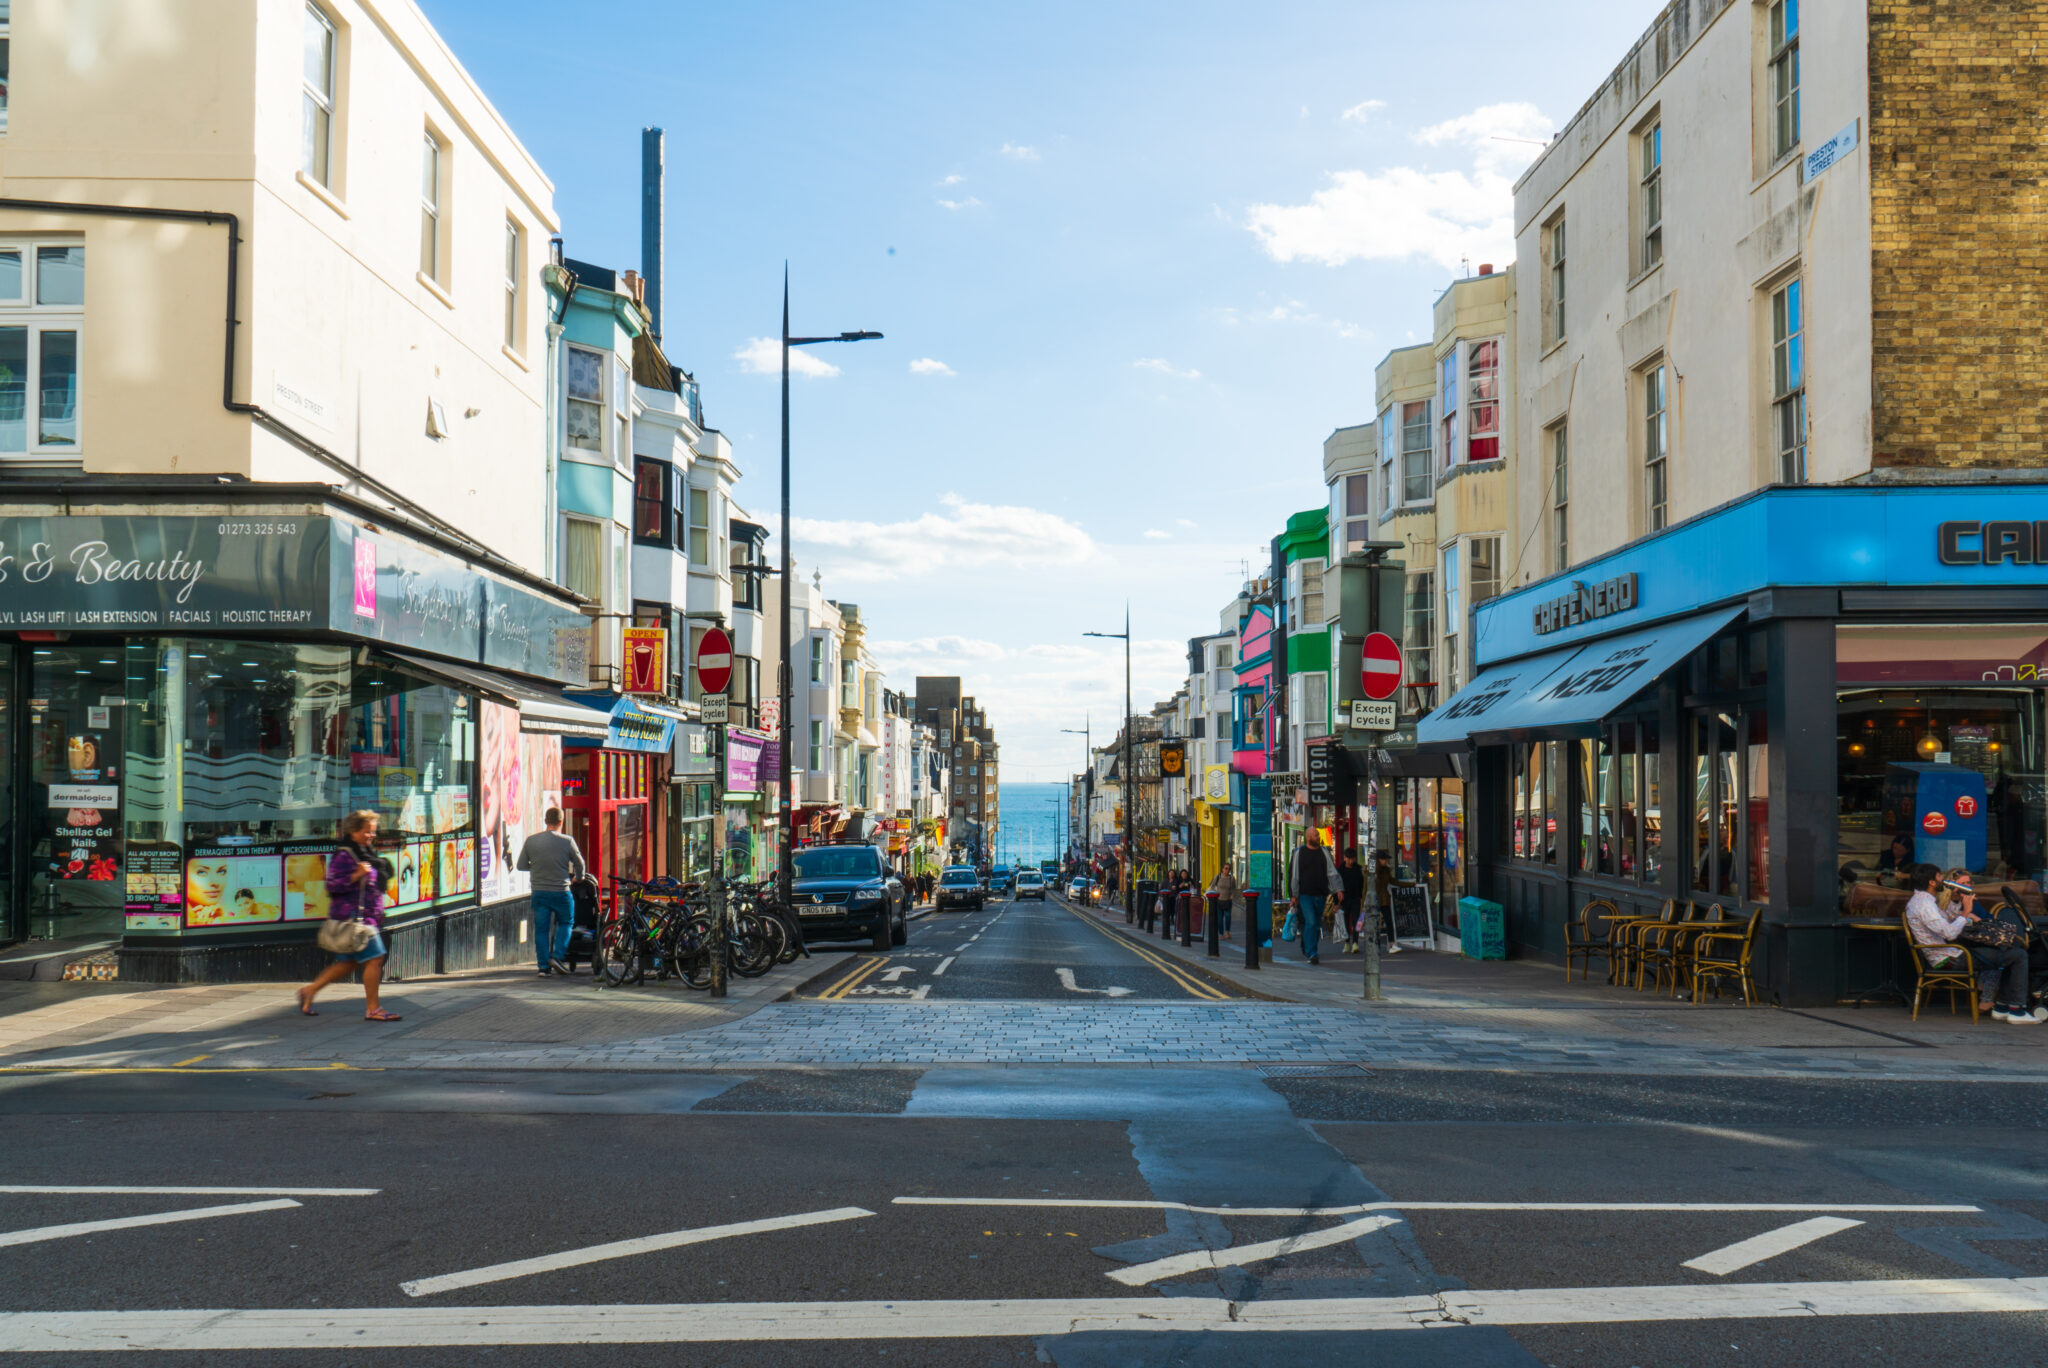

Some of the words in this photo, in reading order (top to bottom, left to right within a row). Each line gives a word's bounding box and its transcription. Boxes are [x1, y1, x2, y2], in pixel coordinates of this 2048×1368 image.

[1808, 136, 1838, 166] PRESTON
[1810, 152, 1834, 176] STREET
[218, 523, 252, 535] 01273
[254, 523, 274, 535] 325
[276, 523, 296, 535] 543
[70, 541, 206, 604] Beauty
[1582, 572, 1638, 621] NERO
[20, 611, 46, 624] LASH
[48, 611, 65, 624] LIFT
[76, 610, 100, 624] LASH
[102, 610, 158, 623] EXTENSION
[170, 610, 211, 623] FACIALS
[222, 610, 266, 623] HOLISTIC
[269, 610, 312, 622] THERAPY
[624, 640, 634, 690] KEBABS
[1537, 658, 1649, 702] NERO
[703, 696, 726, 712] Except
[1355, 703, 1392, 716] Except
[1436, 689, 1512, 722] NERO
[703, 708, 726, 719] cycles
[1356, 715, 1391, 727] cycles
[54, 794, 112, 802] dermalogica
[56, 827, 94, 836] Shellac
[96, 827, 112, 836] Gel
[72, 838, 97, 848] Nails
[194, 848, 234, 857] DERMAQUEST
[236, 847, 250, 856] SKIN
[250, 846, 276, 855] THERAPY
